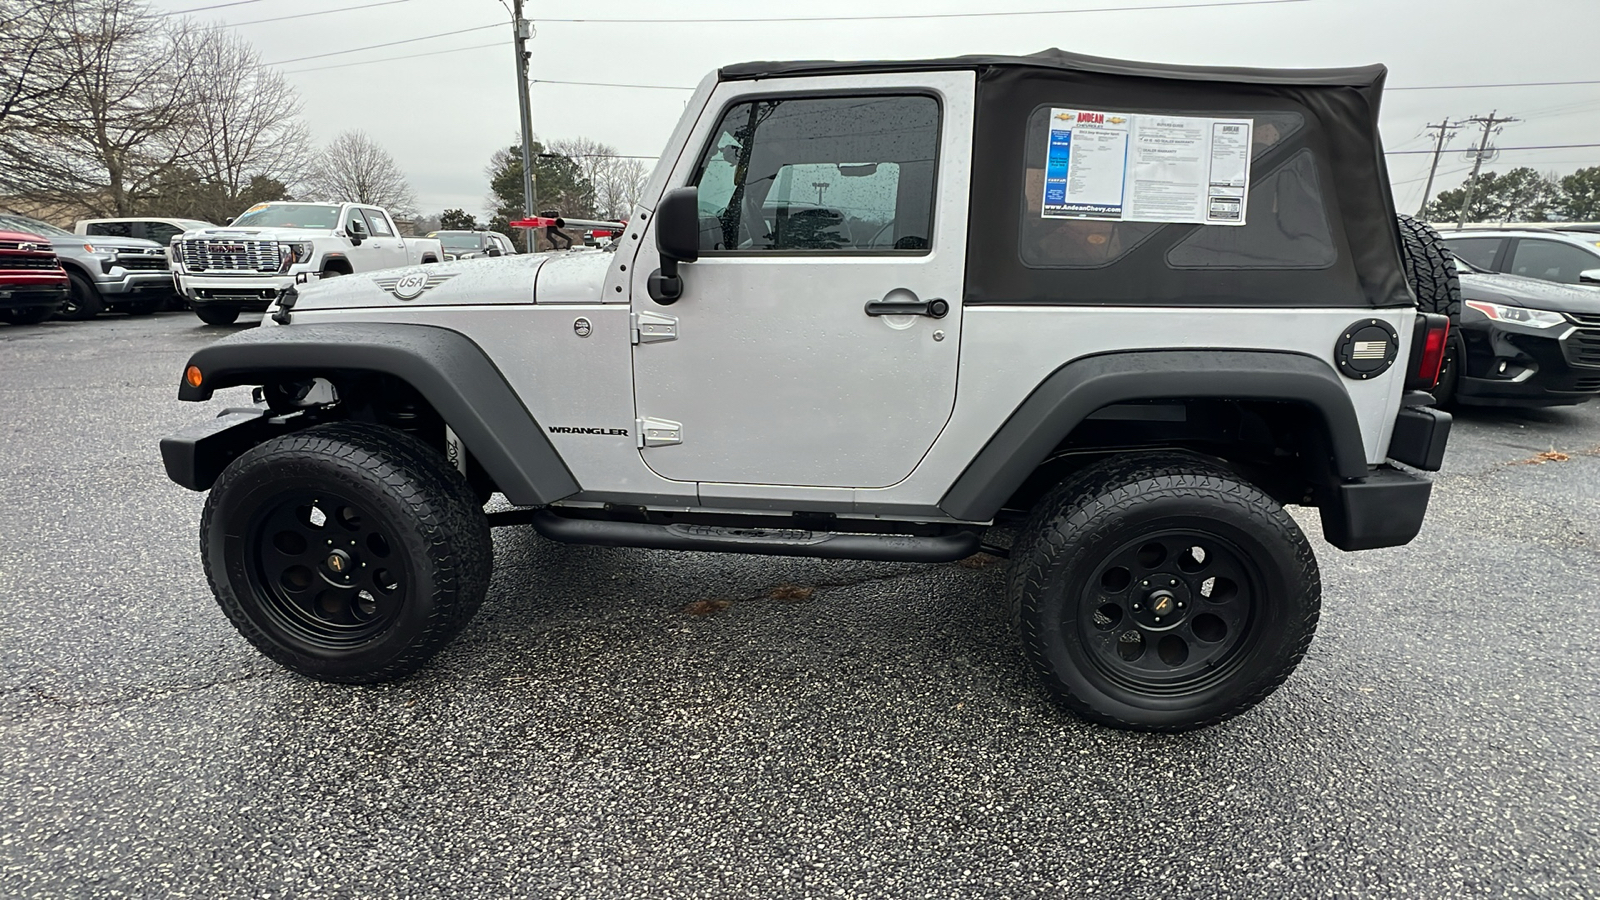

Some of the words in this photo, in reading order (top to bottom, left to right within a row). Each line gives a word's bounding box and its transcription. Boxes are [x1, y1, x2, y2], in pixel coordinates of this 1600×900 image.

[1077, 112, 1104, 124] ANDEAN
[399, 277, 423, 288] USA
[548, 426, 629, 437] WRANGLER
